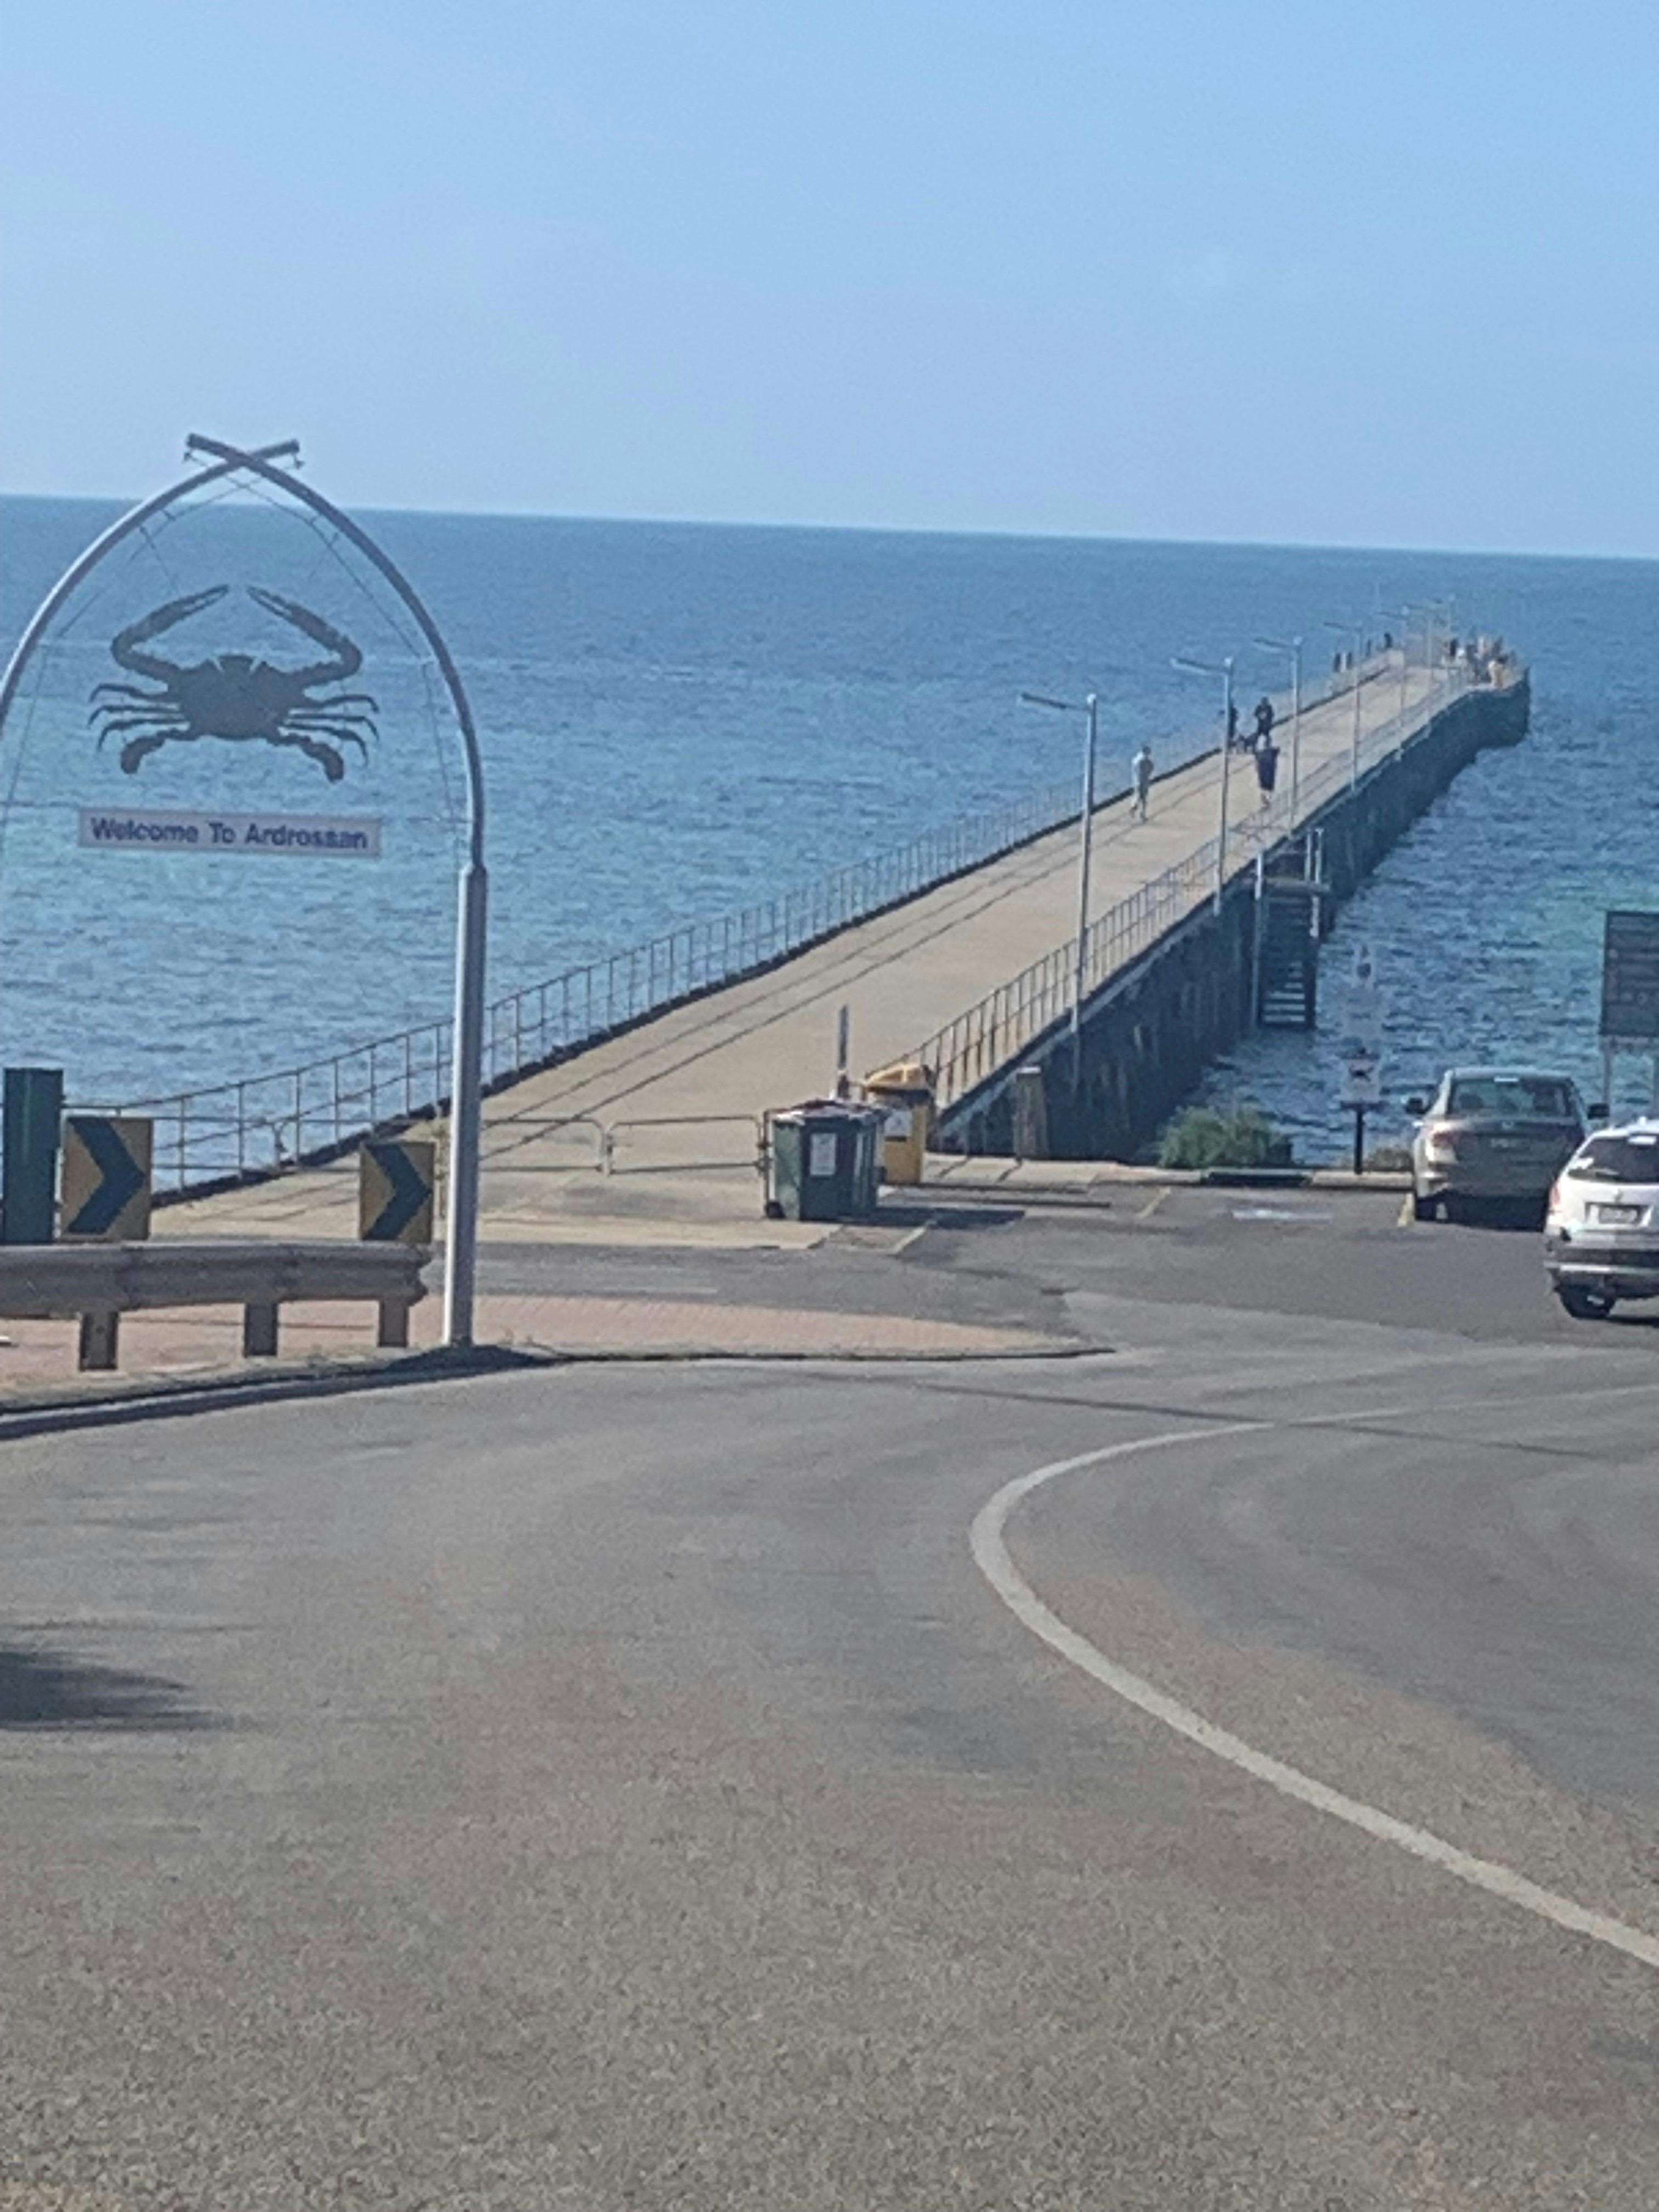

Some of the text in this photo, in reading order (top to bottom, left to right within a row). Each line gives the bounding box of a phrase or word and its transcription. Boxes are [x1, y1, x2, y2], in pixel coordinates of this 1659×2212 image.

[91, 817, 367, 849] Welcome To Ardrossan
